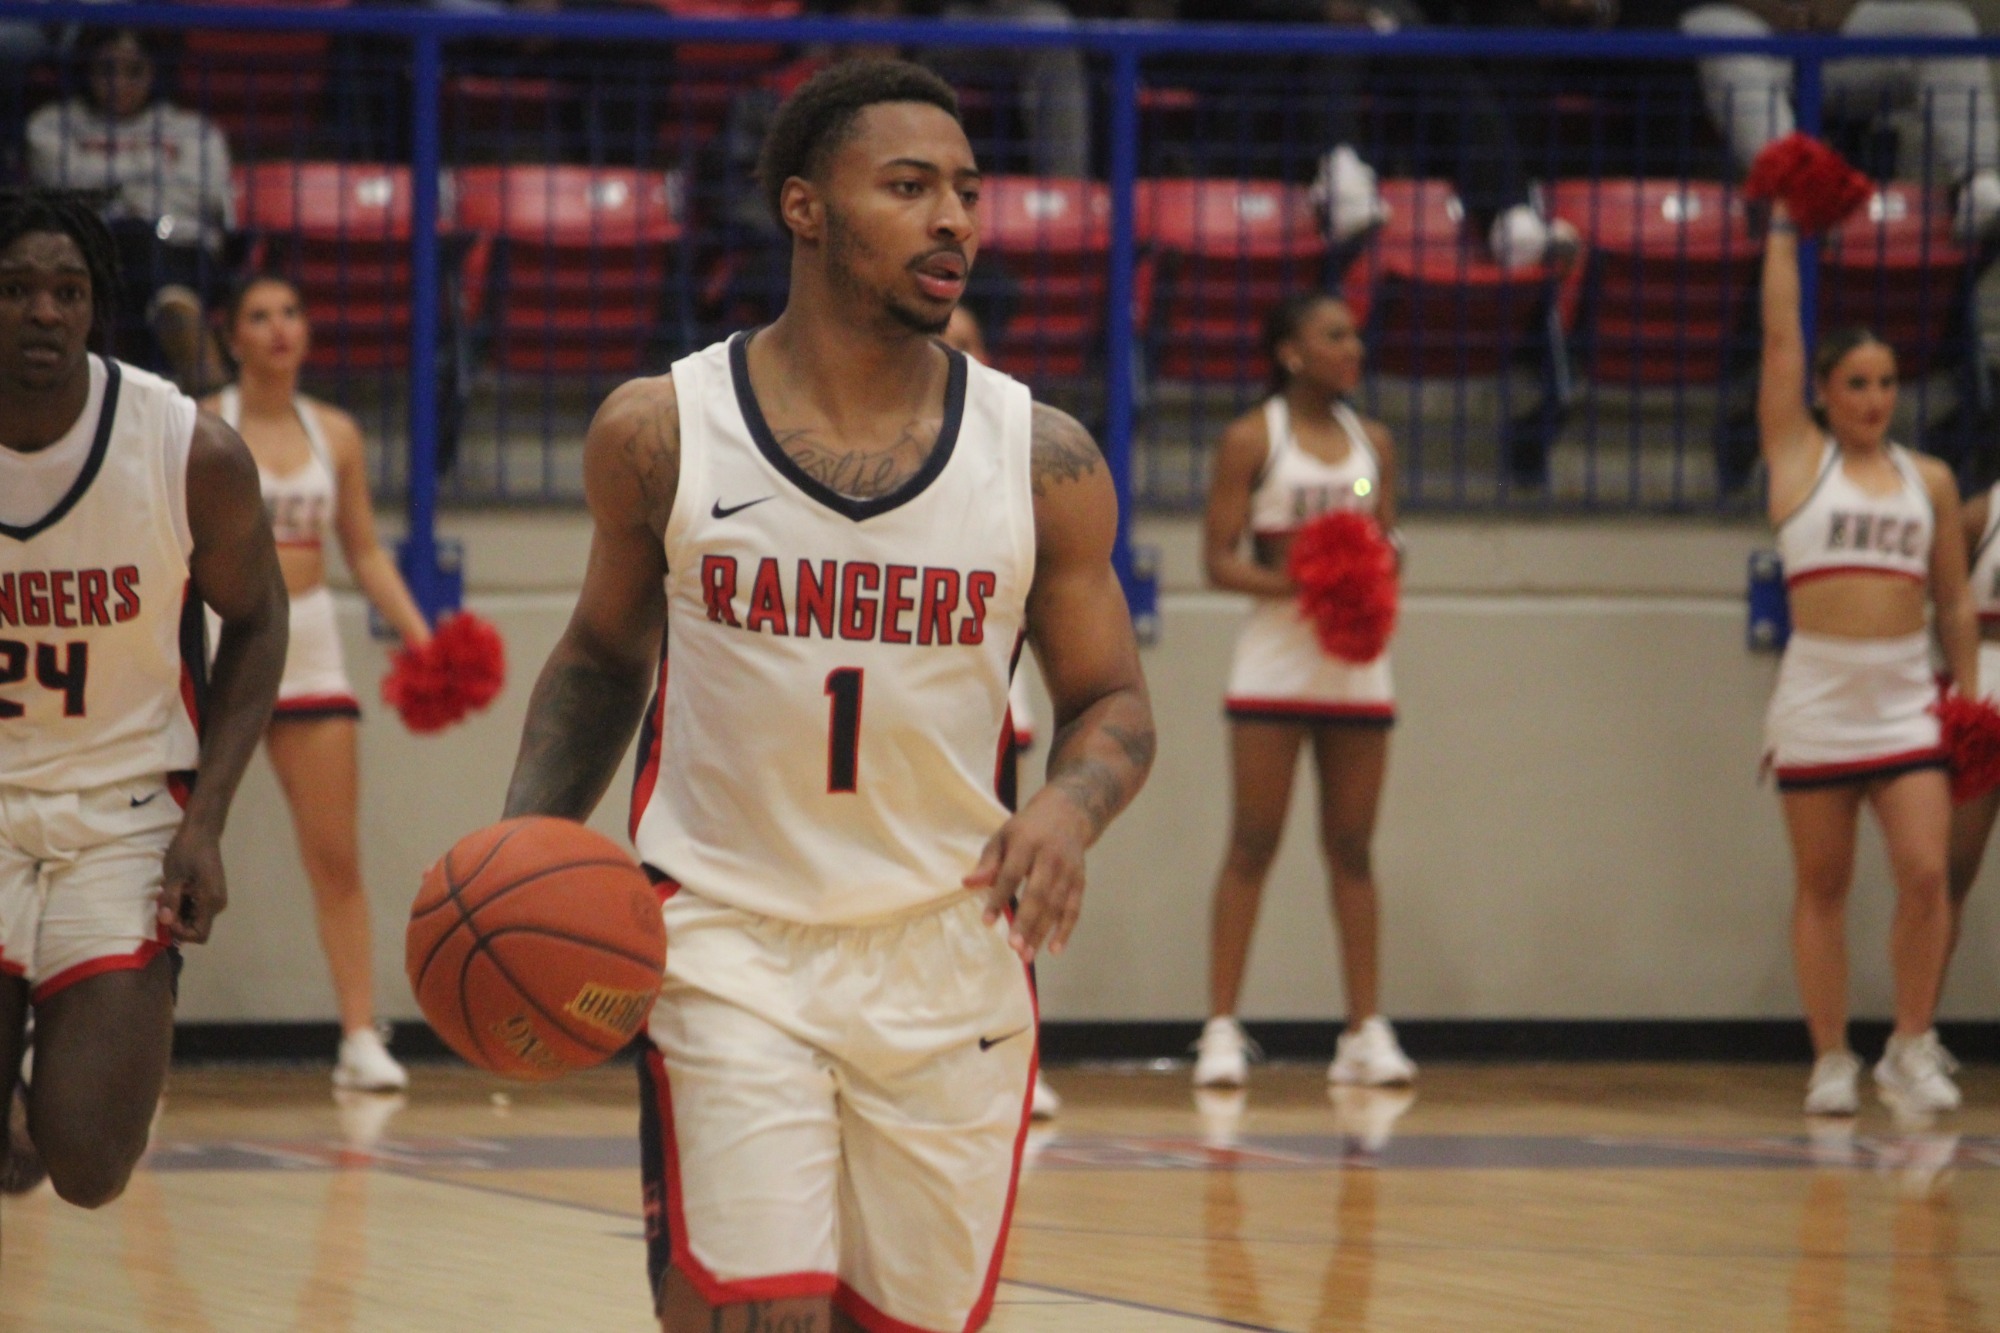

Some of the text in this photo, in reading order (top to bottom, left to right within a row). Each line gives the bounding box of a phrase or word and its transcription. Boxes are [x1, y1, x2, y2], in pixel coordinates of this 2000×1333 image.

[701, 555, 997, 646] RANGERS
[0, 637, 88, 720] 24
[824, 666, 864, 794] 1
